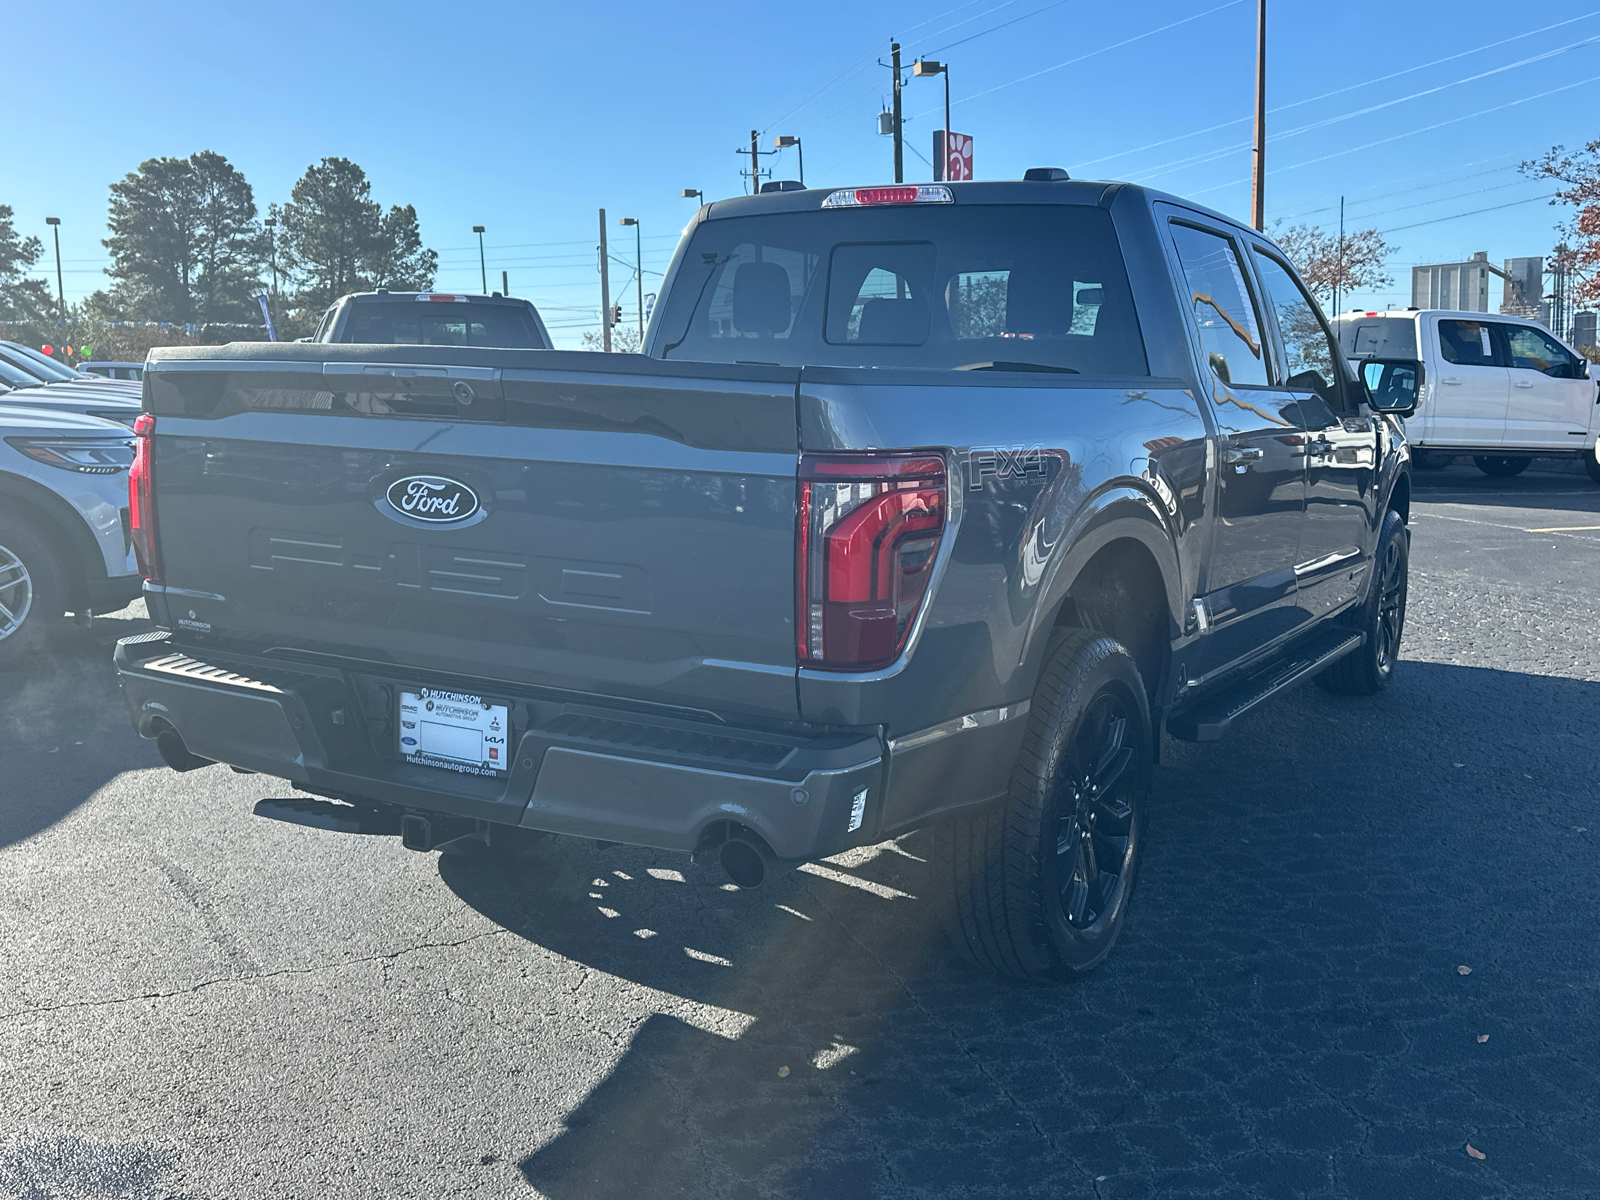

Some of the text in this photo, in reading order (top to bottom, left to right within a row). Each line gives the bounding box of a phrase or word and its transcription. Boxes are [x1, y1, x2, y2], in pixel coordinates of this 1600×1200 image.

[968, 443, 1047, 491] FX4
[401, 481, 461, 515] Ford
[178, 618, 211, 629] HUTCHINSON
[430, 689, 482, 705] HUTCHINSON
[435, 703, 480, 717] HUTCHINSON
[485, 736, 504, 744] KIA
[406, 754, 497, 777] Hutchinsonautogroup.com
